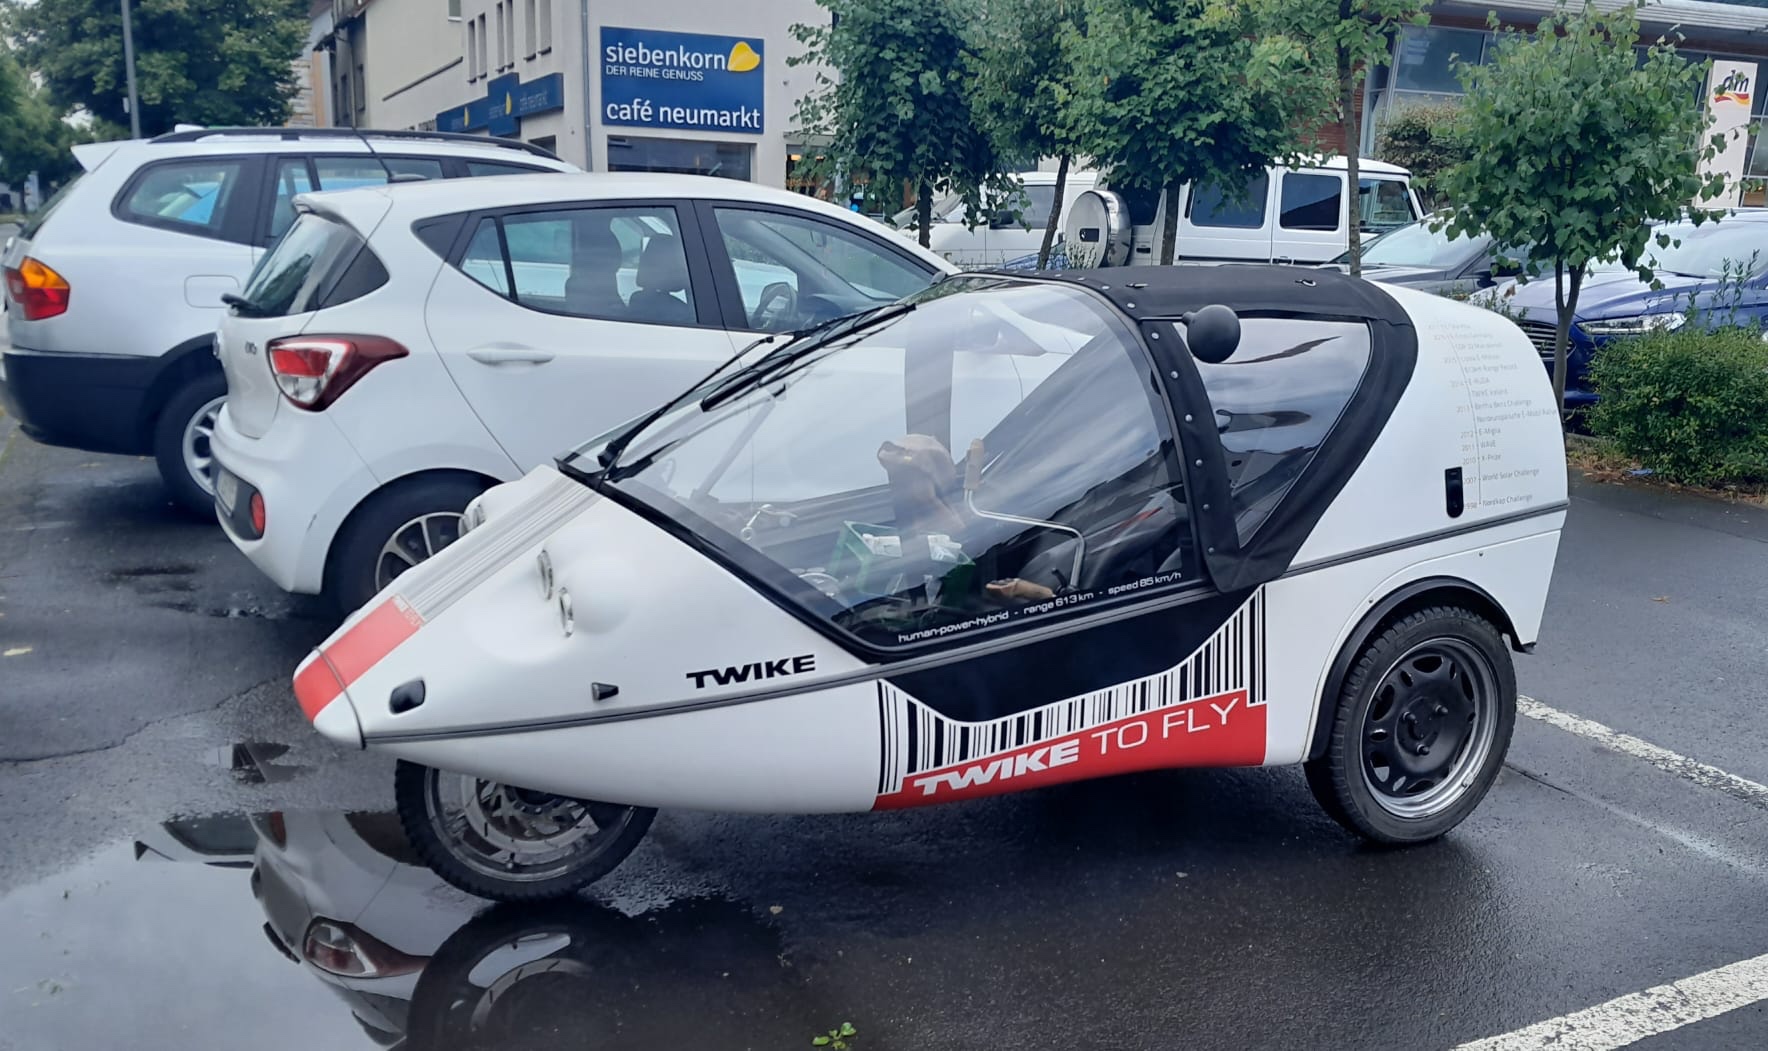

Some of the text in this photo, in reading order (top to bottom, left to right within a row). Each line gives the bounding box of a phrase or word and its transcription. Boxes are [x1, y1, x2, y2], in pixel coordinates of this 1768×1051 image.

[606, 42, 726, 70] siebenkorn
[606, 64, 704, 81] DER REINE GENUSS
[606, 98, 761, 129] café neumarkt
[1513, 467, 1540, 478] Challenge
[898, 610, 1009, 643] human-power-hybrid
[1023, 601, 1055, 616] range
[1055, 594, 1078, 608] 613
[1108, 581, 1139, 596] speed
[1139, 576, 1155, 588] 85
[1155, 571, 1182, 585] km/h
[686, 654, 816, 689] TWIKE
[913, 698, 1239, 796] TWIKE TO FLY
